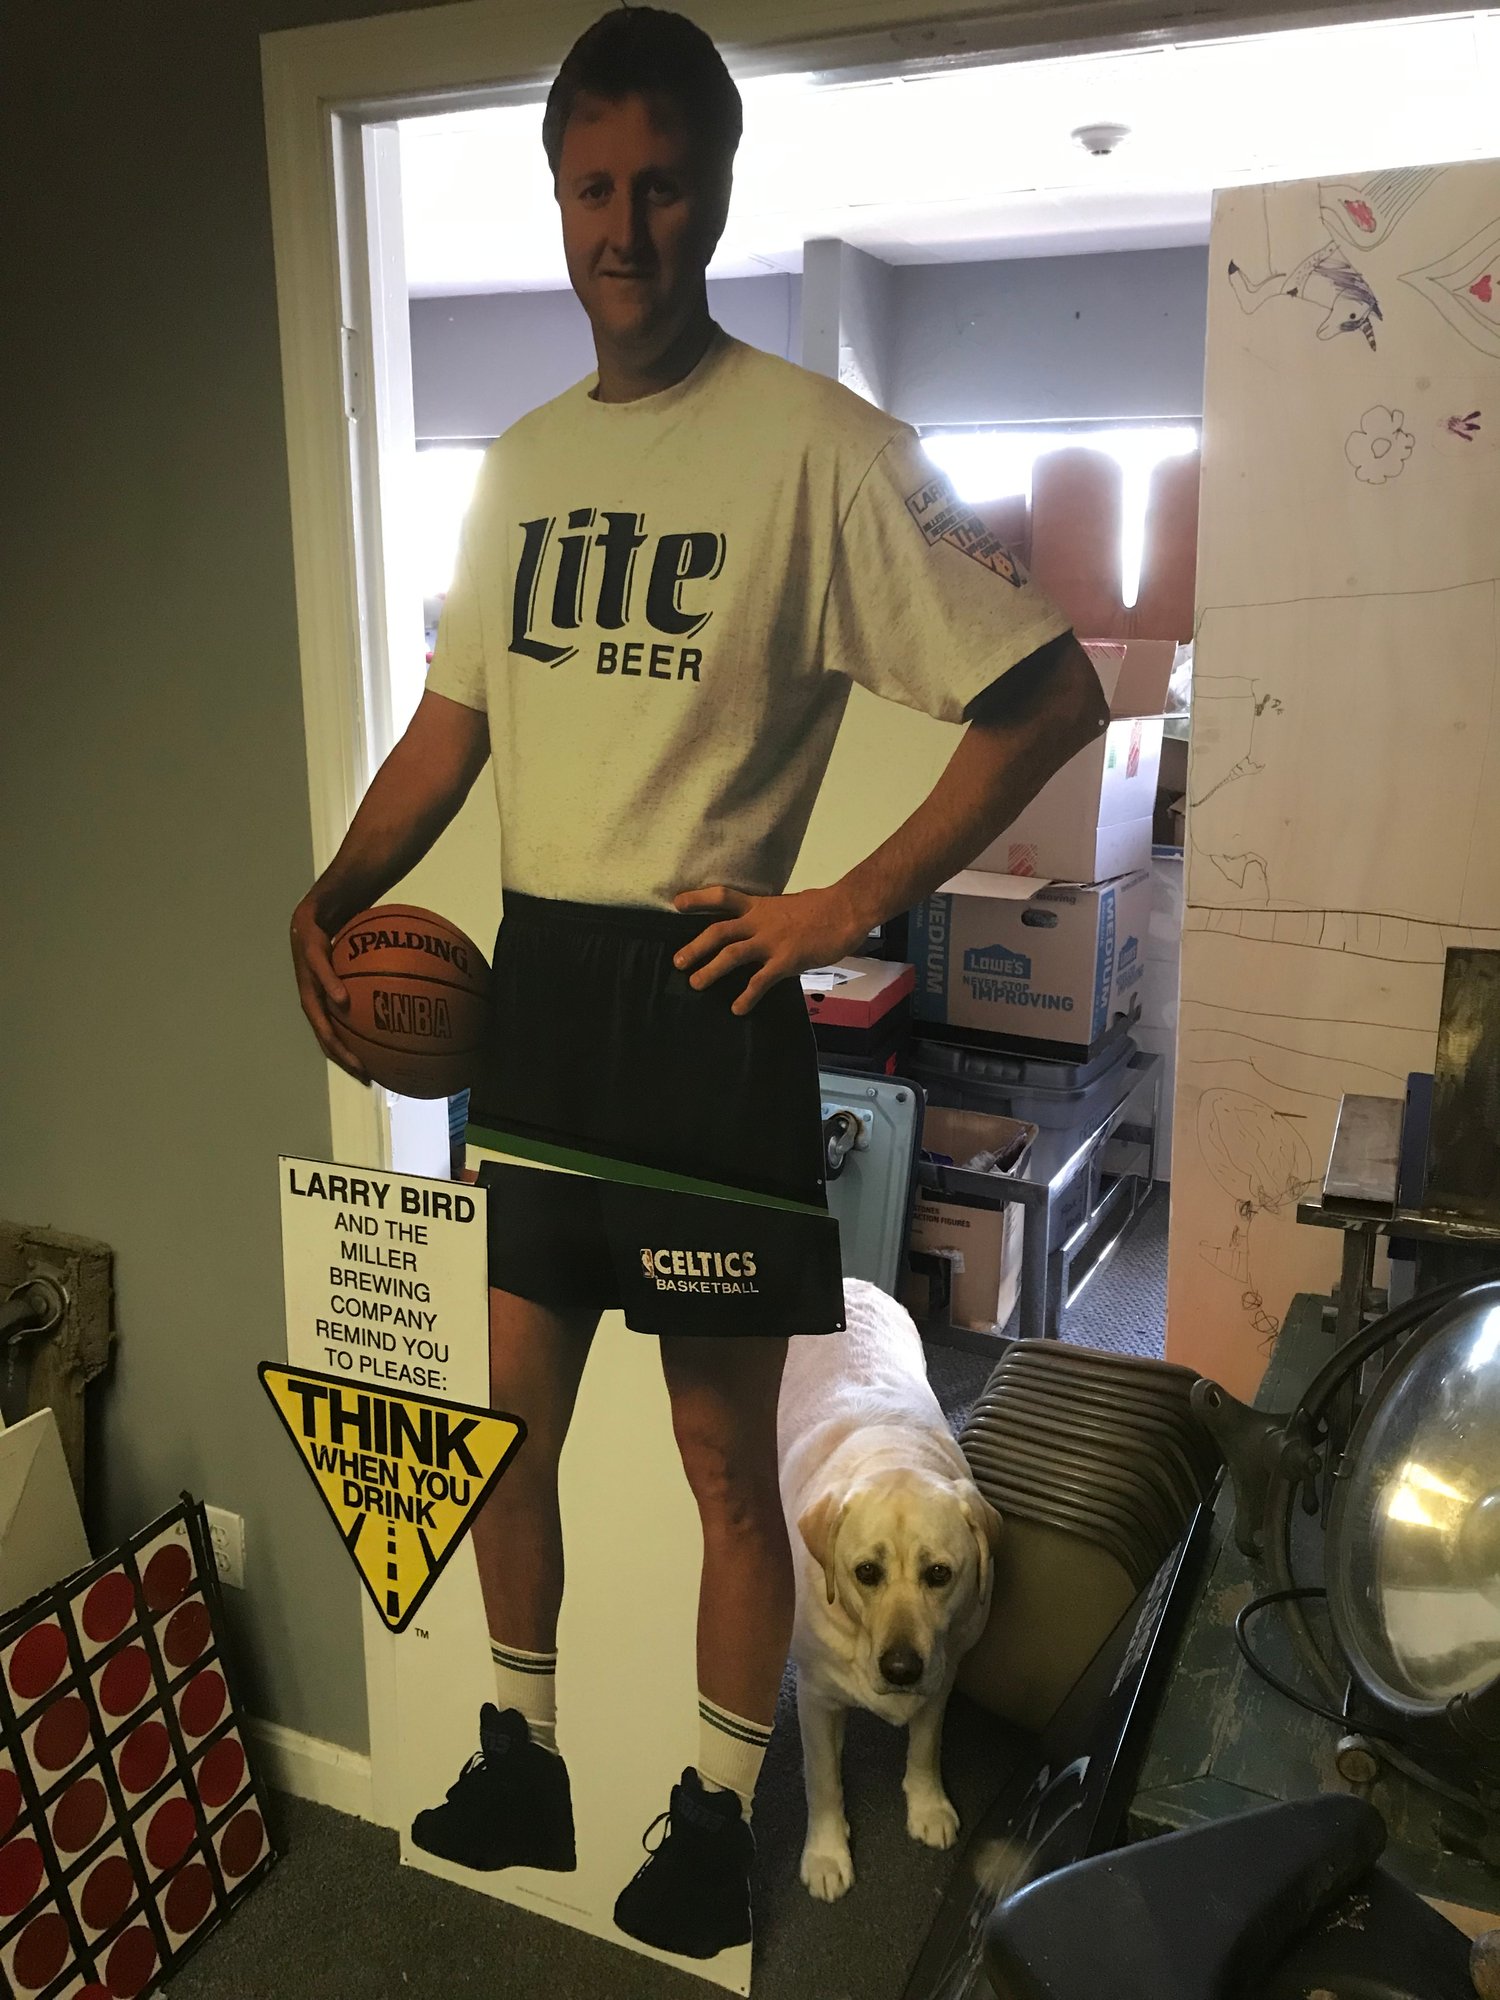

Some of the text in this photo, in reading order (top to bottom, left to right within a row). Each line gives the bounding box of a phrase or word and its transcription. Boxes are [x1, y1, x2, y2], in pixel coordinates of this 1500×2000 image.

[508, 508, 727, 669] Lite
[597, 642, 703, 682] BEER
[348, 930, 469, 975] SPALDING
[971, 954, 1024, 976] LOWE'S
[1100, 896, 1114, 1009] MEDIUM
[962, 975, 1030, 993] NEVER STOP
[971, 984, 1074, 1012] IMPROVING
[390, 992, 453, 1039] NBA
[289, 1168, 475, 1224] LARRY BIRD
[334, 1212, 428, 1246] AND THE
[940, 1216, 971, 1228] FIGURES
[341, 1241, 417, 1272] MILLER
[654, 1249, 758, 1278] CELTICS
[330, 1266, 431, 1303] BREWING
[656, 1279, 760, 1294] BASKETBALL
[330, 1294, 438, 1332] COMPANY
[316, 1318, 449, 1363] REMIND YOU
[324, 1347, 447, 1391] TO PLEASE:
[287, 1379, 484, 1479] THINK
[310, 1442, 471, 1507] WHEN YOU
[343, 1480, 437, 1530] DRINK
